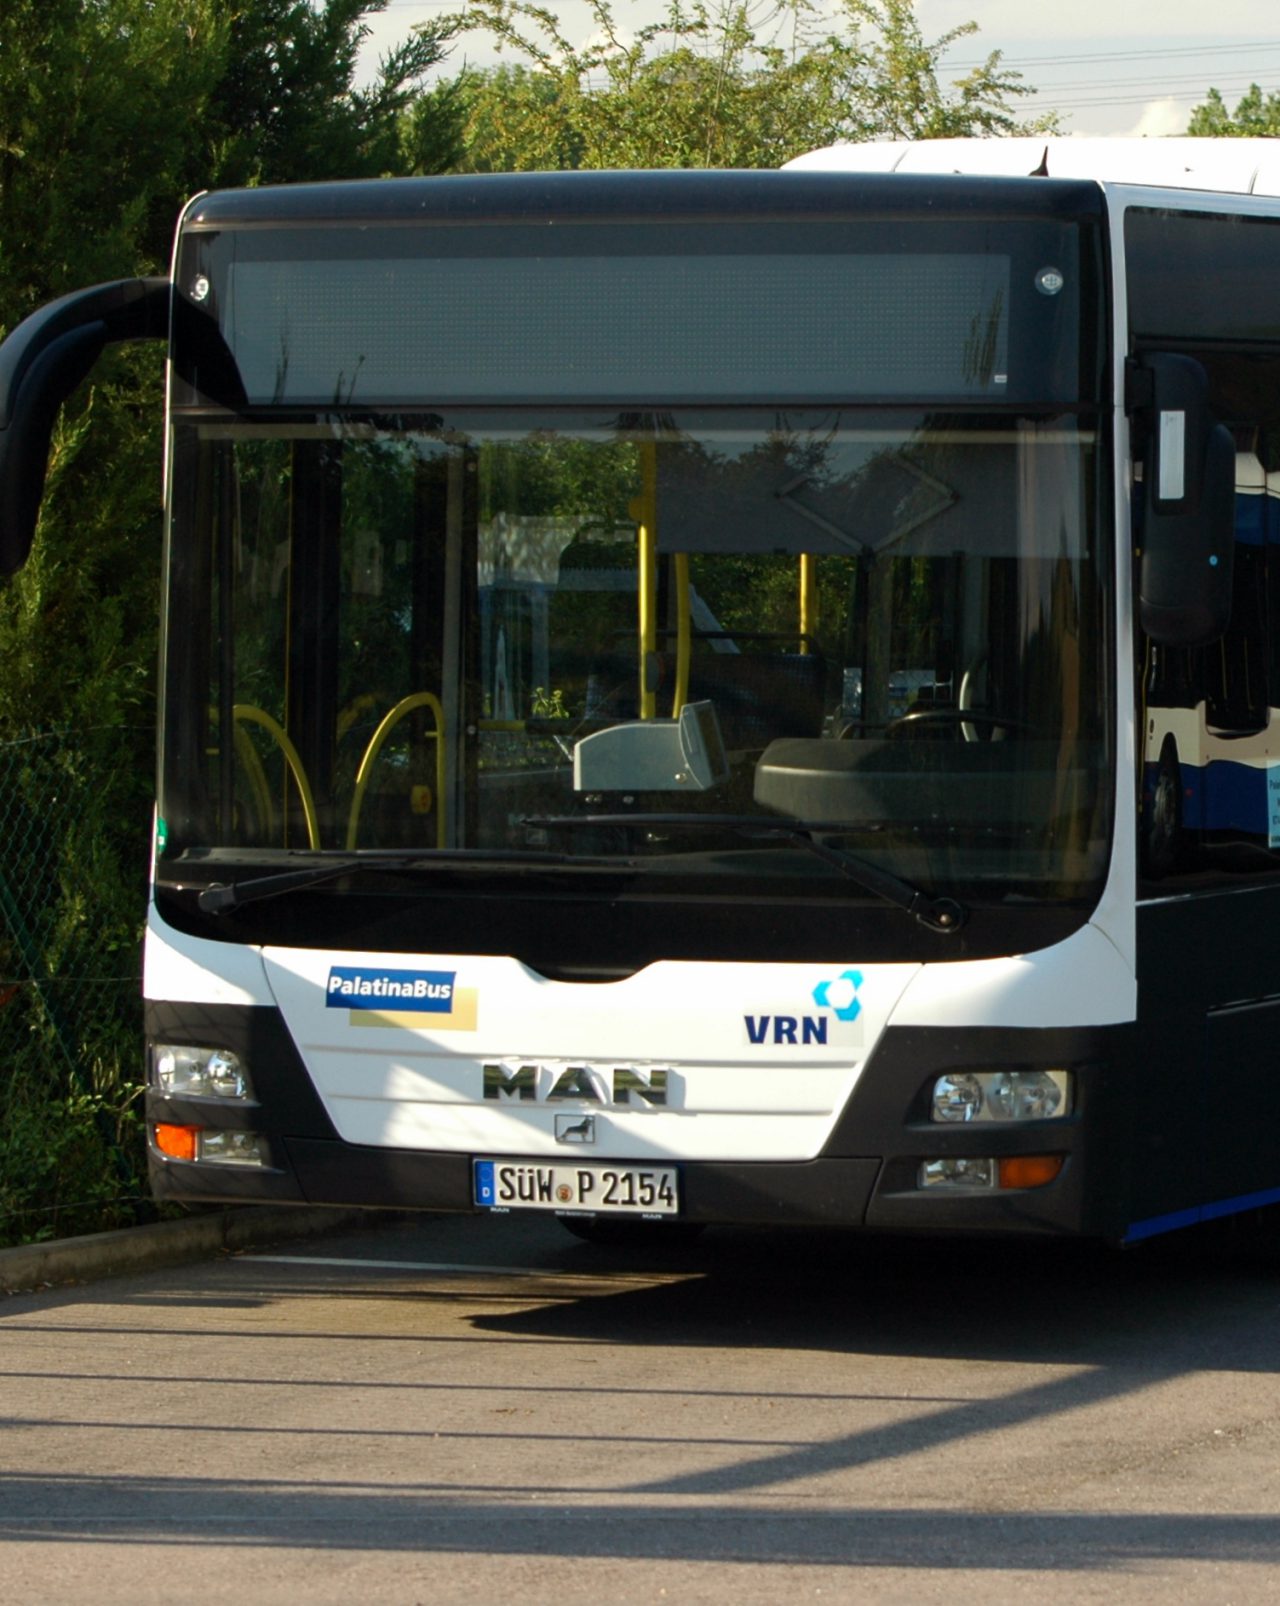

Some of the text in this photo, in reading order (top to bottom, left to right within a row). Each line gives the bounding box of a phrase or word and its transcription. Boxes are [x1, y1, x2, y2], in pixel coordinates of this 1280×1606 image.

[327, 974, 452, 1001] PalatinaBus
[743, 1014, 829, 1046] VRN
[482, 1063, 669, 1105] MAN
[481, 1187, 491, 1198] D
[499, 1167, 675, 1207] SÜW P 2154
